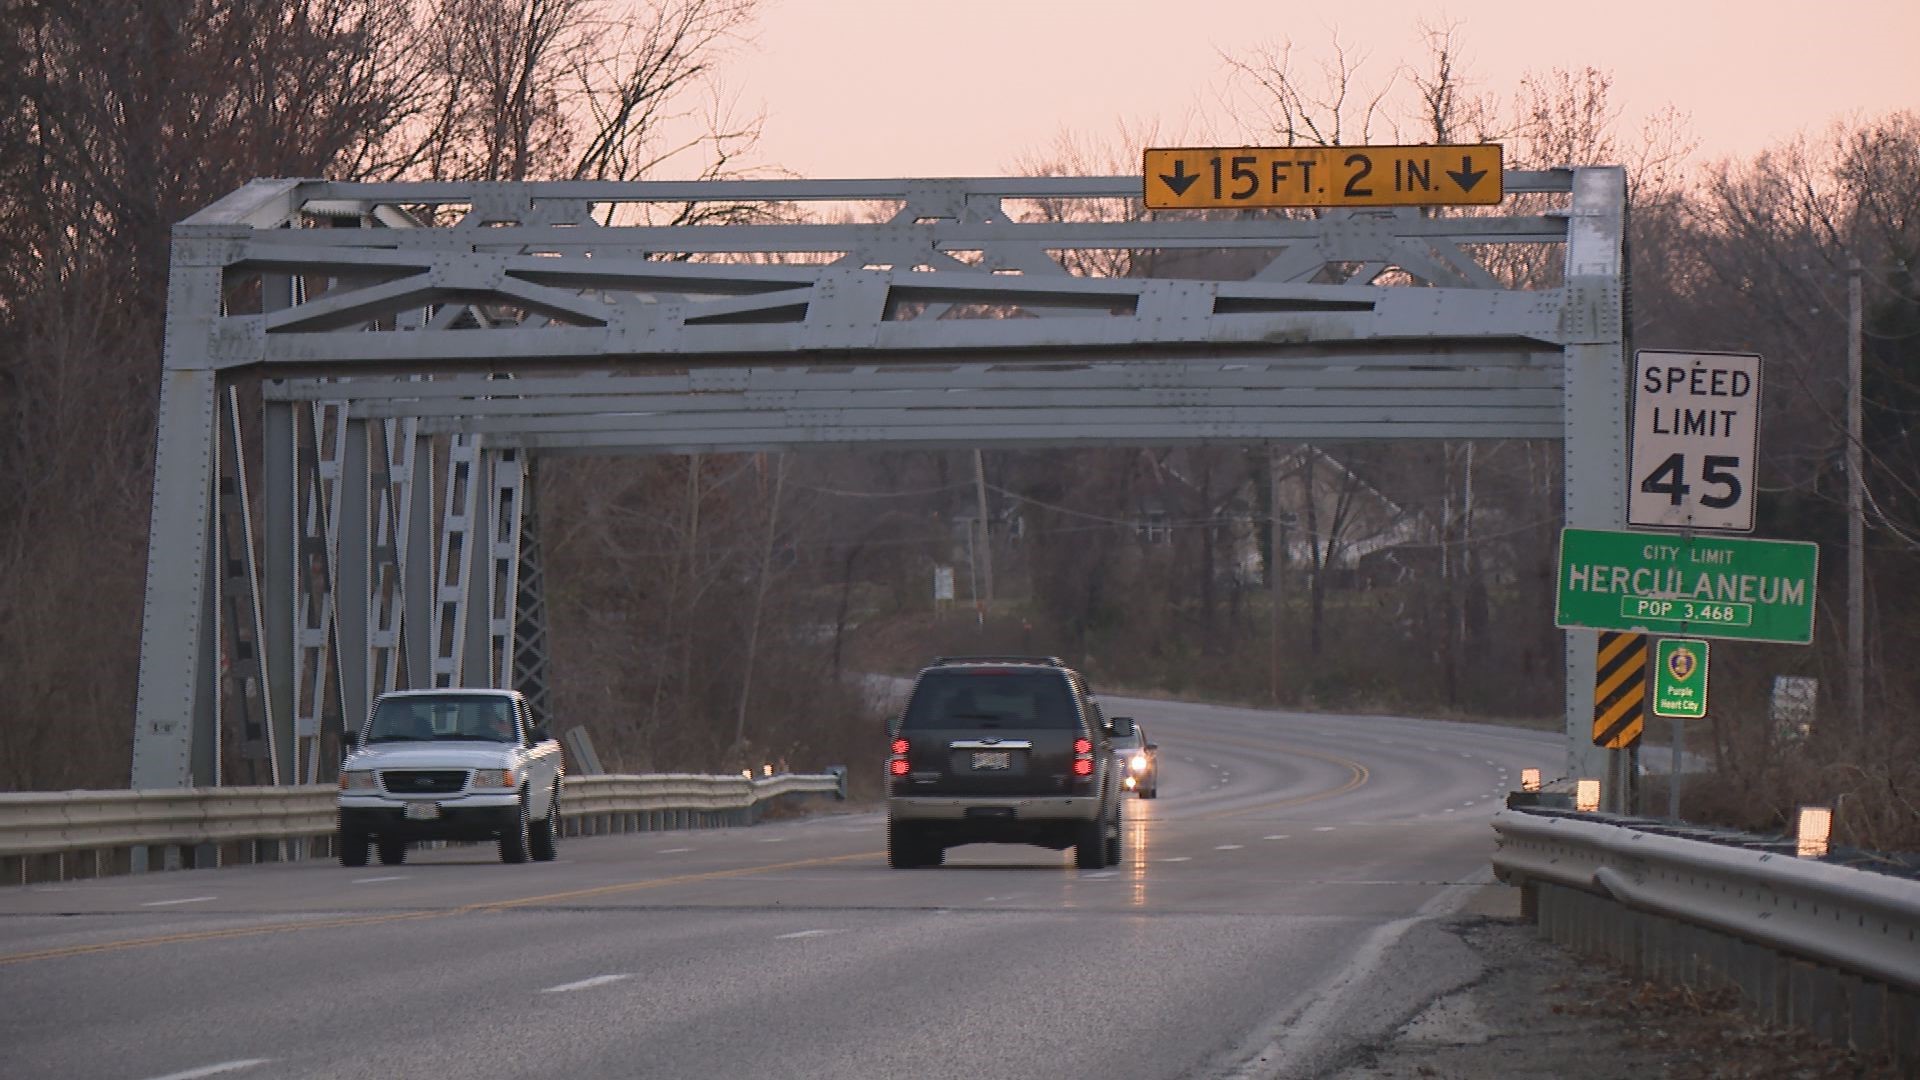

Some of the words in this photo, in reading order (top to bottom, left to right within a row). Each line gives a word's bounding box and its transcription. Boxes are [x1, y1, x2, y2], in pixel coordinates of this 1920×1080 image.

[1210, 156, 1259, 200] 15
[1272, 160, 1325, 194] FT.
[1344, 154, 1373, 197] 2
[1395, 158, 1440, 192] IN.
[1644, 366, 1750, 397] SPEED
[1653, 406, 1737, 437] LIMIT
[1641, 452, 1742, 510] 45
[1643, 544, 1680, 563] CITY
[1690, 548, 1735, 565] LIMIT
[1568, 562, 1806, 606] HERCULANEUM
[1637, 600, 1673, 616] POP
[1661, 699, 1682, 710] Heart
[1682, 700, 1699, 713] City
[1667, 685, 1694, 697] Purple
